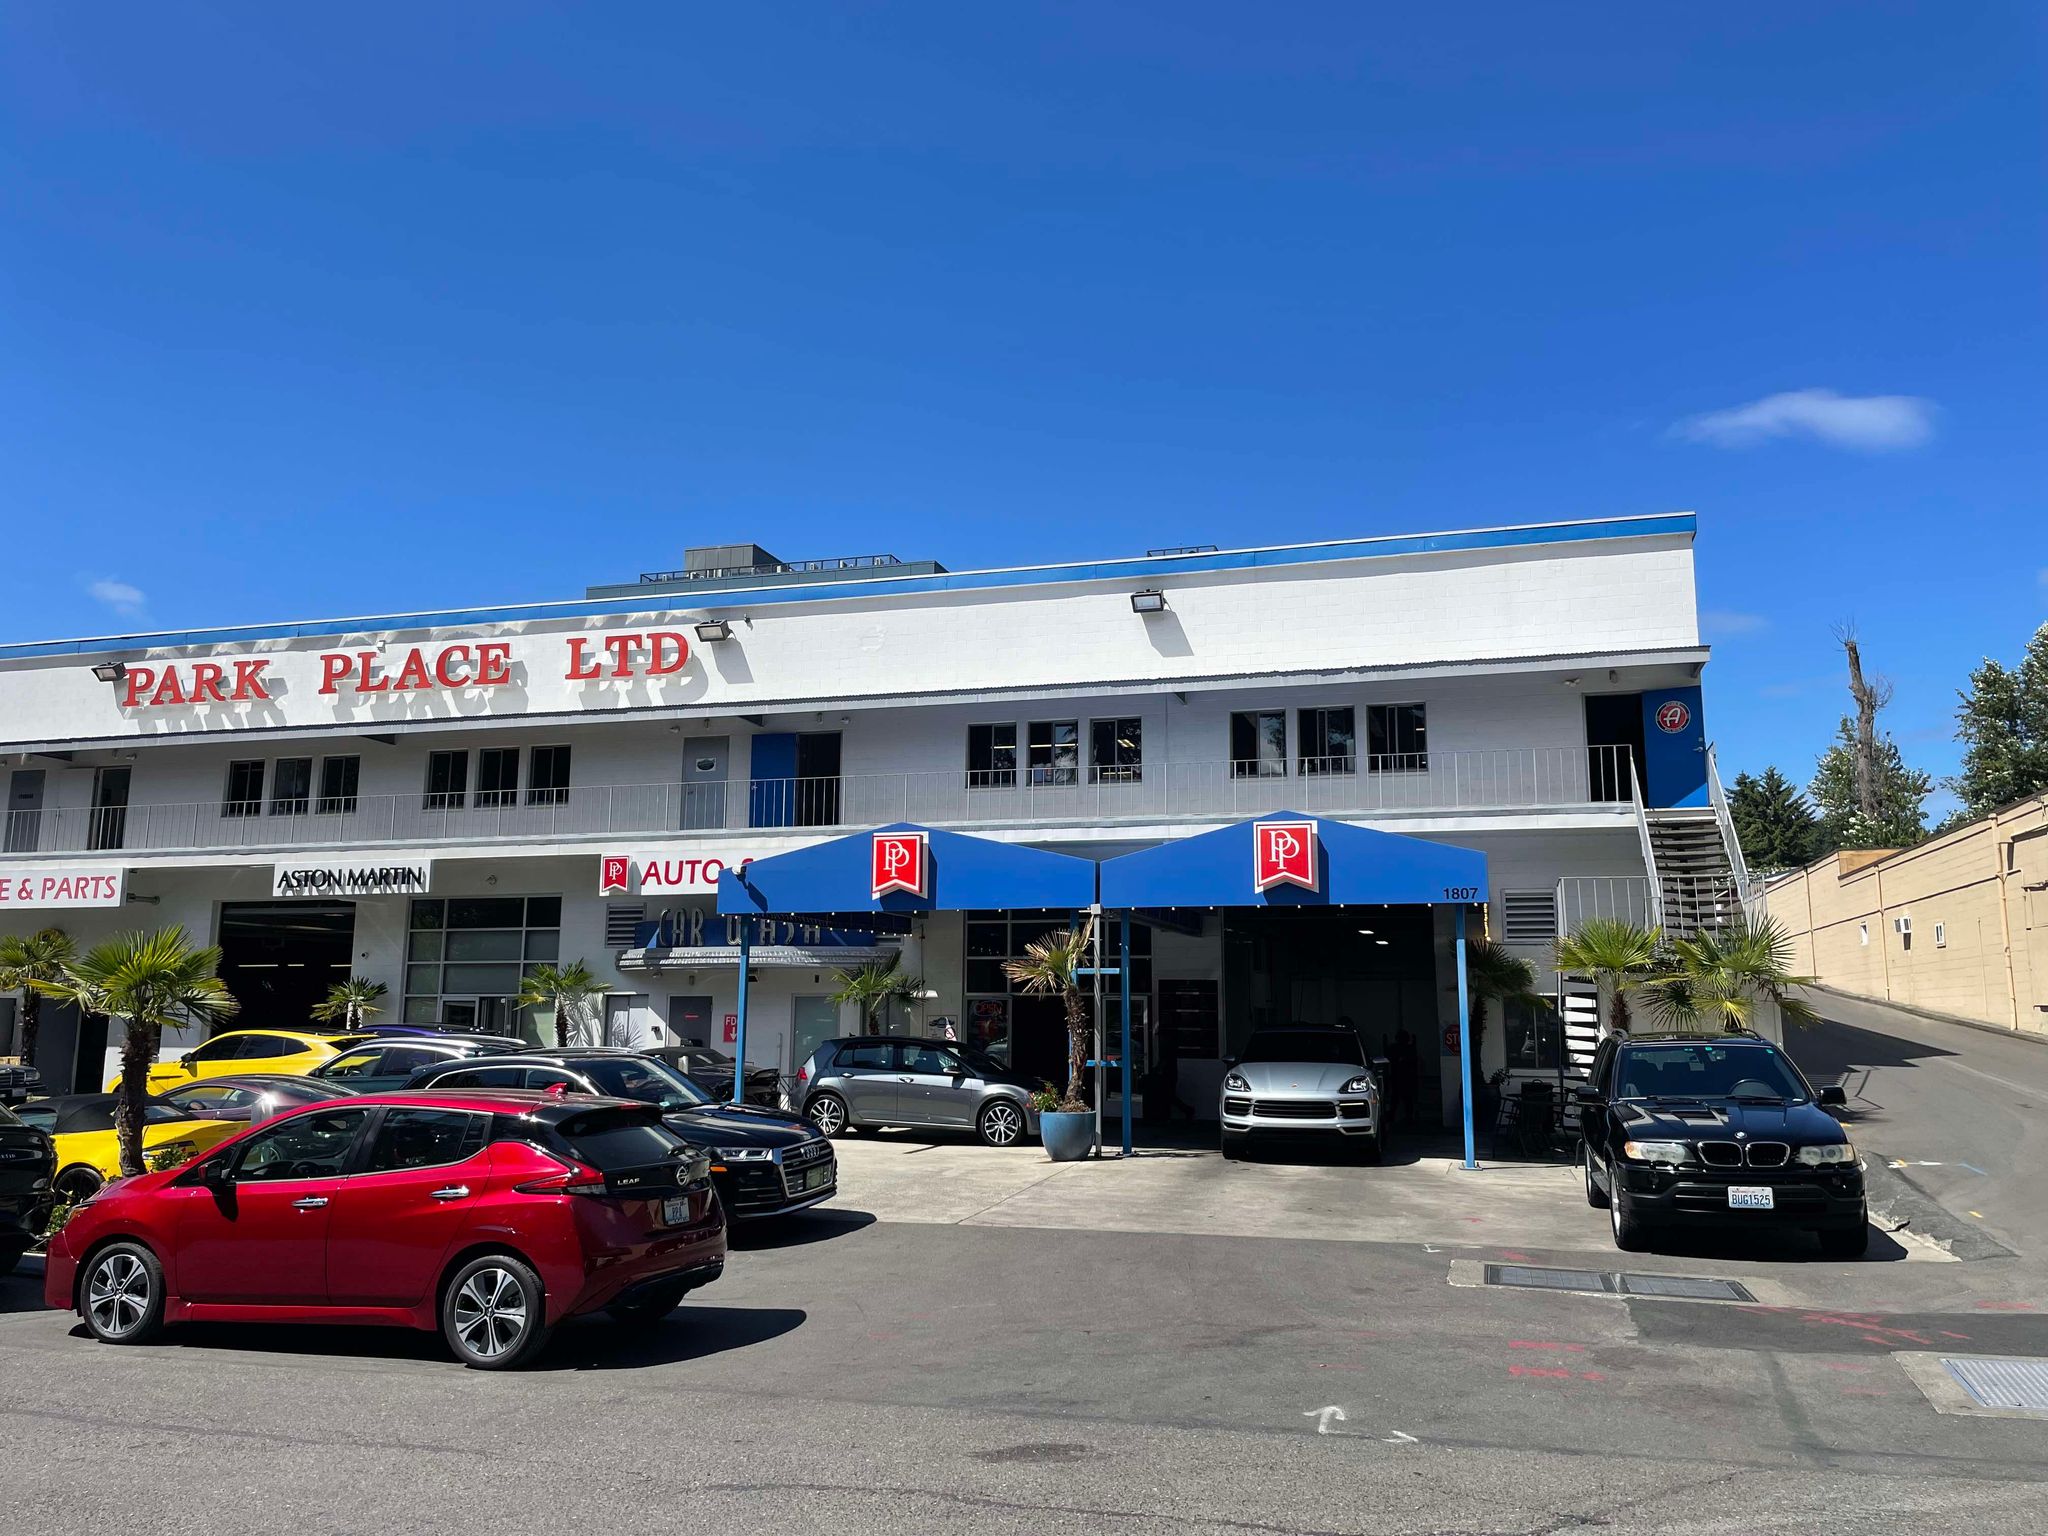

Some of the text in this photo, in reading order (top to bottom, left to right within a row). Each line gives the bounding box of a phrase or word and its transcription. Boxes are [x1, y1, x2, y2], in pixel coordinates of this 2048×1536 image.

[122, 632, 689, 707] PARK PLACE LTD
[277, 867, 422, 888] ASTON MARTIN
[640, 858, 725, 886] AUTO
[17, 878, 33, 900] &
[41, 876, 116, 899] PARTS
[1443, 887, 1478, 900] 1807
[658, 907, 704, 947] CAR
[725, 1016, 737, 1026] FD
[1446, 1033, 1458, 1045] ST
[617, 1177, 640, 1186] LEAF
[1731, 1194, 1771, 1206] BUG1525
